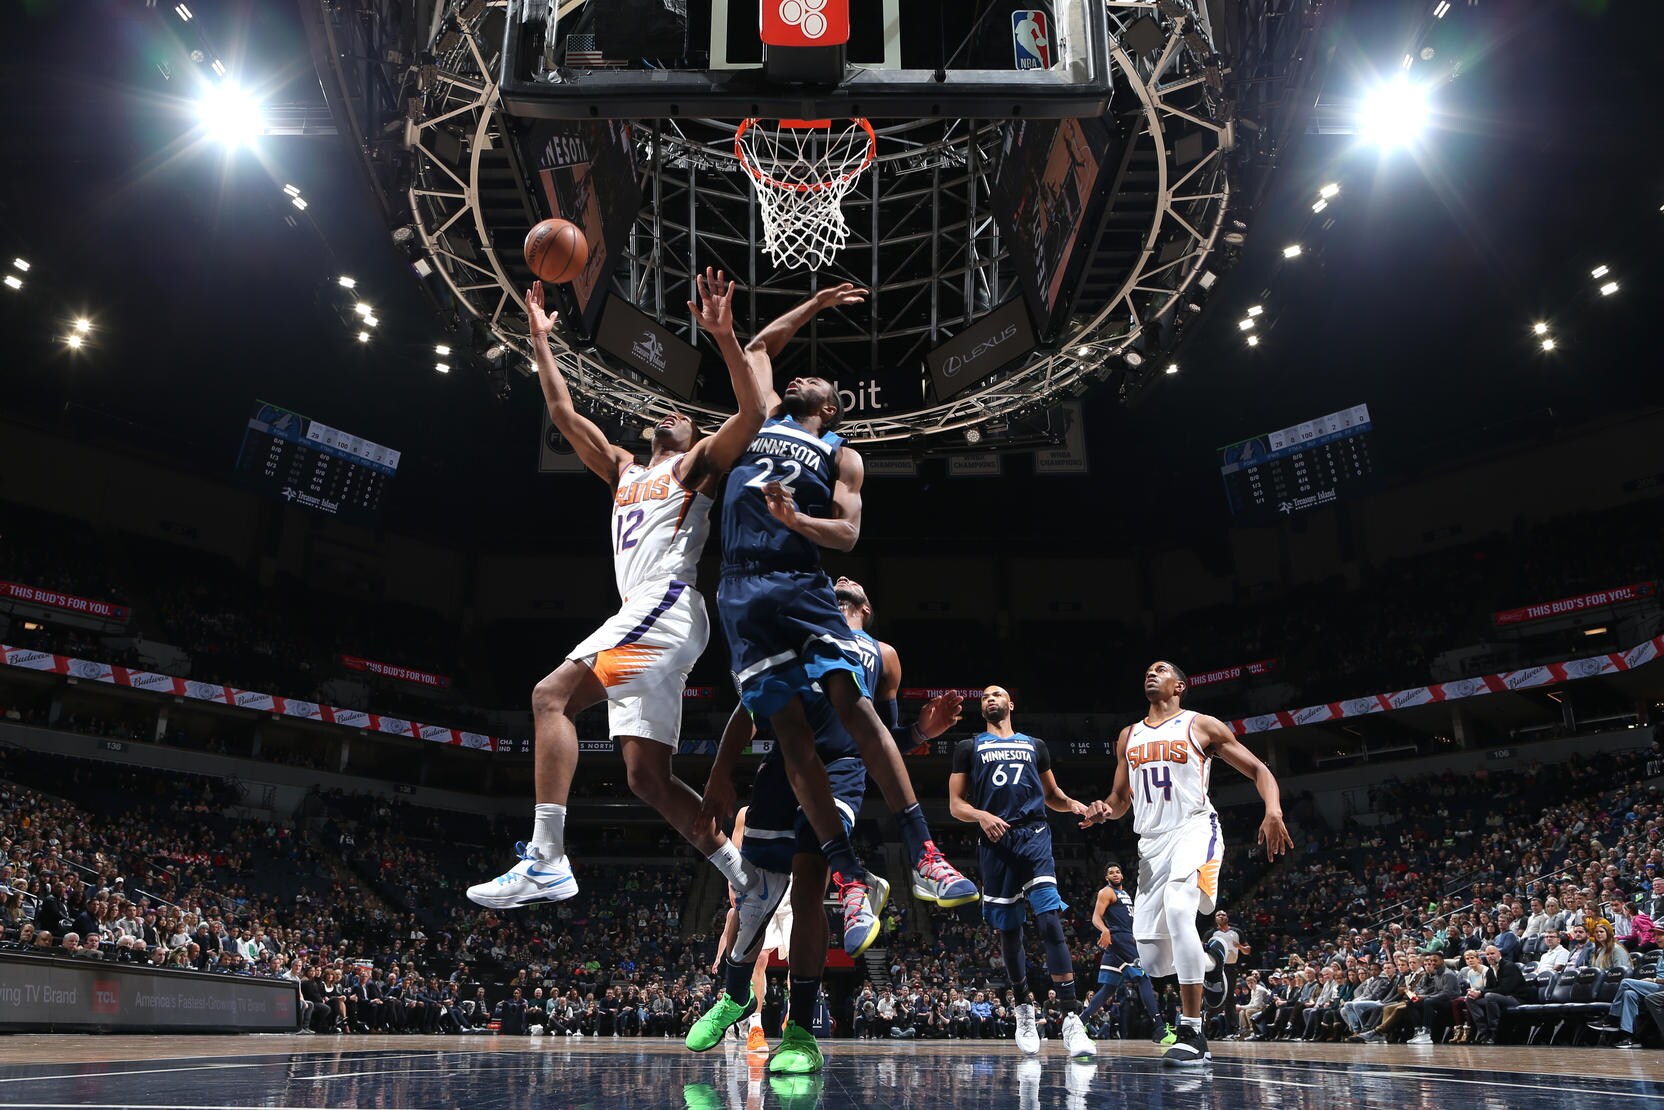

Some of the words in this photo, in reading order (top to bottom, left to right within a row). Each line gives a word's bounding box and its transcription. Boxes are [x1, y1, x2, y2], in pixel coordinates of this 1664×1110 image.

[1020, 58, 1038, 69] NBA
[541, 136, 589, 168] NESOTA
[963, 324, 1016, 363] LEXUS
[747, 438, 821, 471] MINNESOTA
[745, 457, 801, 494] 22
[616, 508, 645, 555] 12
[10, 585, 33, 599] THIS
[34, 590, 66, 606] BUD'S
[67, 599, 87, 610] FOR
[89, 602, 111, 616] YOU.
[1527, 607, 1550, 618] THIS
[1552, 597, 1584, 613] BUD'S
[1585, 594, 1606, 608] FOR
[1607, 588, 1635, 601] YOU.
[383, 666, 405, 677] BUD'S
[406, 671, 421, 681] FOR
[421, 674, 438, 684] YOU.
[1190, 674, 1207, 685] THIS
[1207, 670, 1230, 682] BUD'S
[1231, 667, 1242, 677] FO
[927, 689, 943, 698] THIS
[763, 741, 770, 751] 8
[981, 750, 1032, 764] MINNESOTA
[1127, 740, 1188, 771] SUNS
[992, 763, 1025, 786] 67
[1141, 766, 1172, 803] 14
[24, 984, 41, 1002] TV
[43, 986, 77, 1004] Brand
[96, 991, 116, 1004] TCL
[135, 992, 176, 1009] America's
